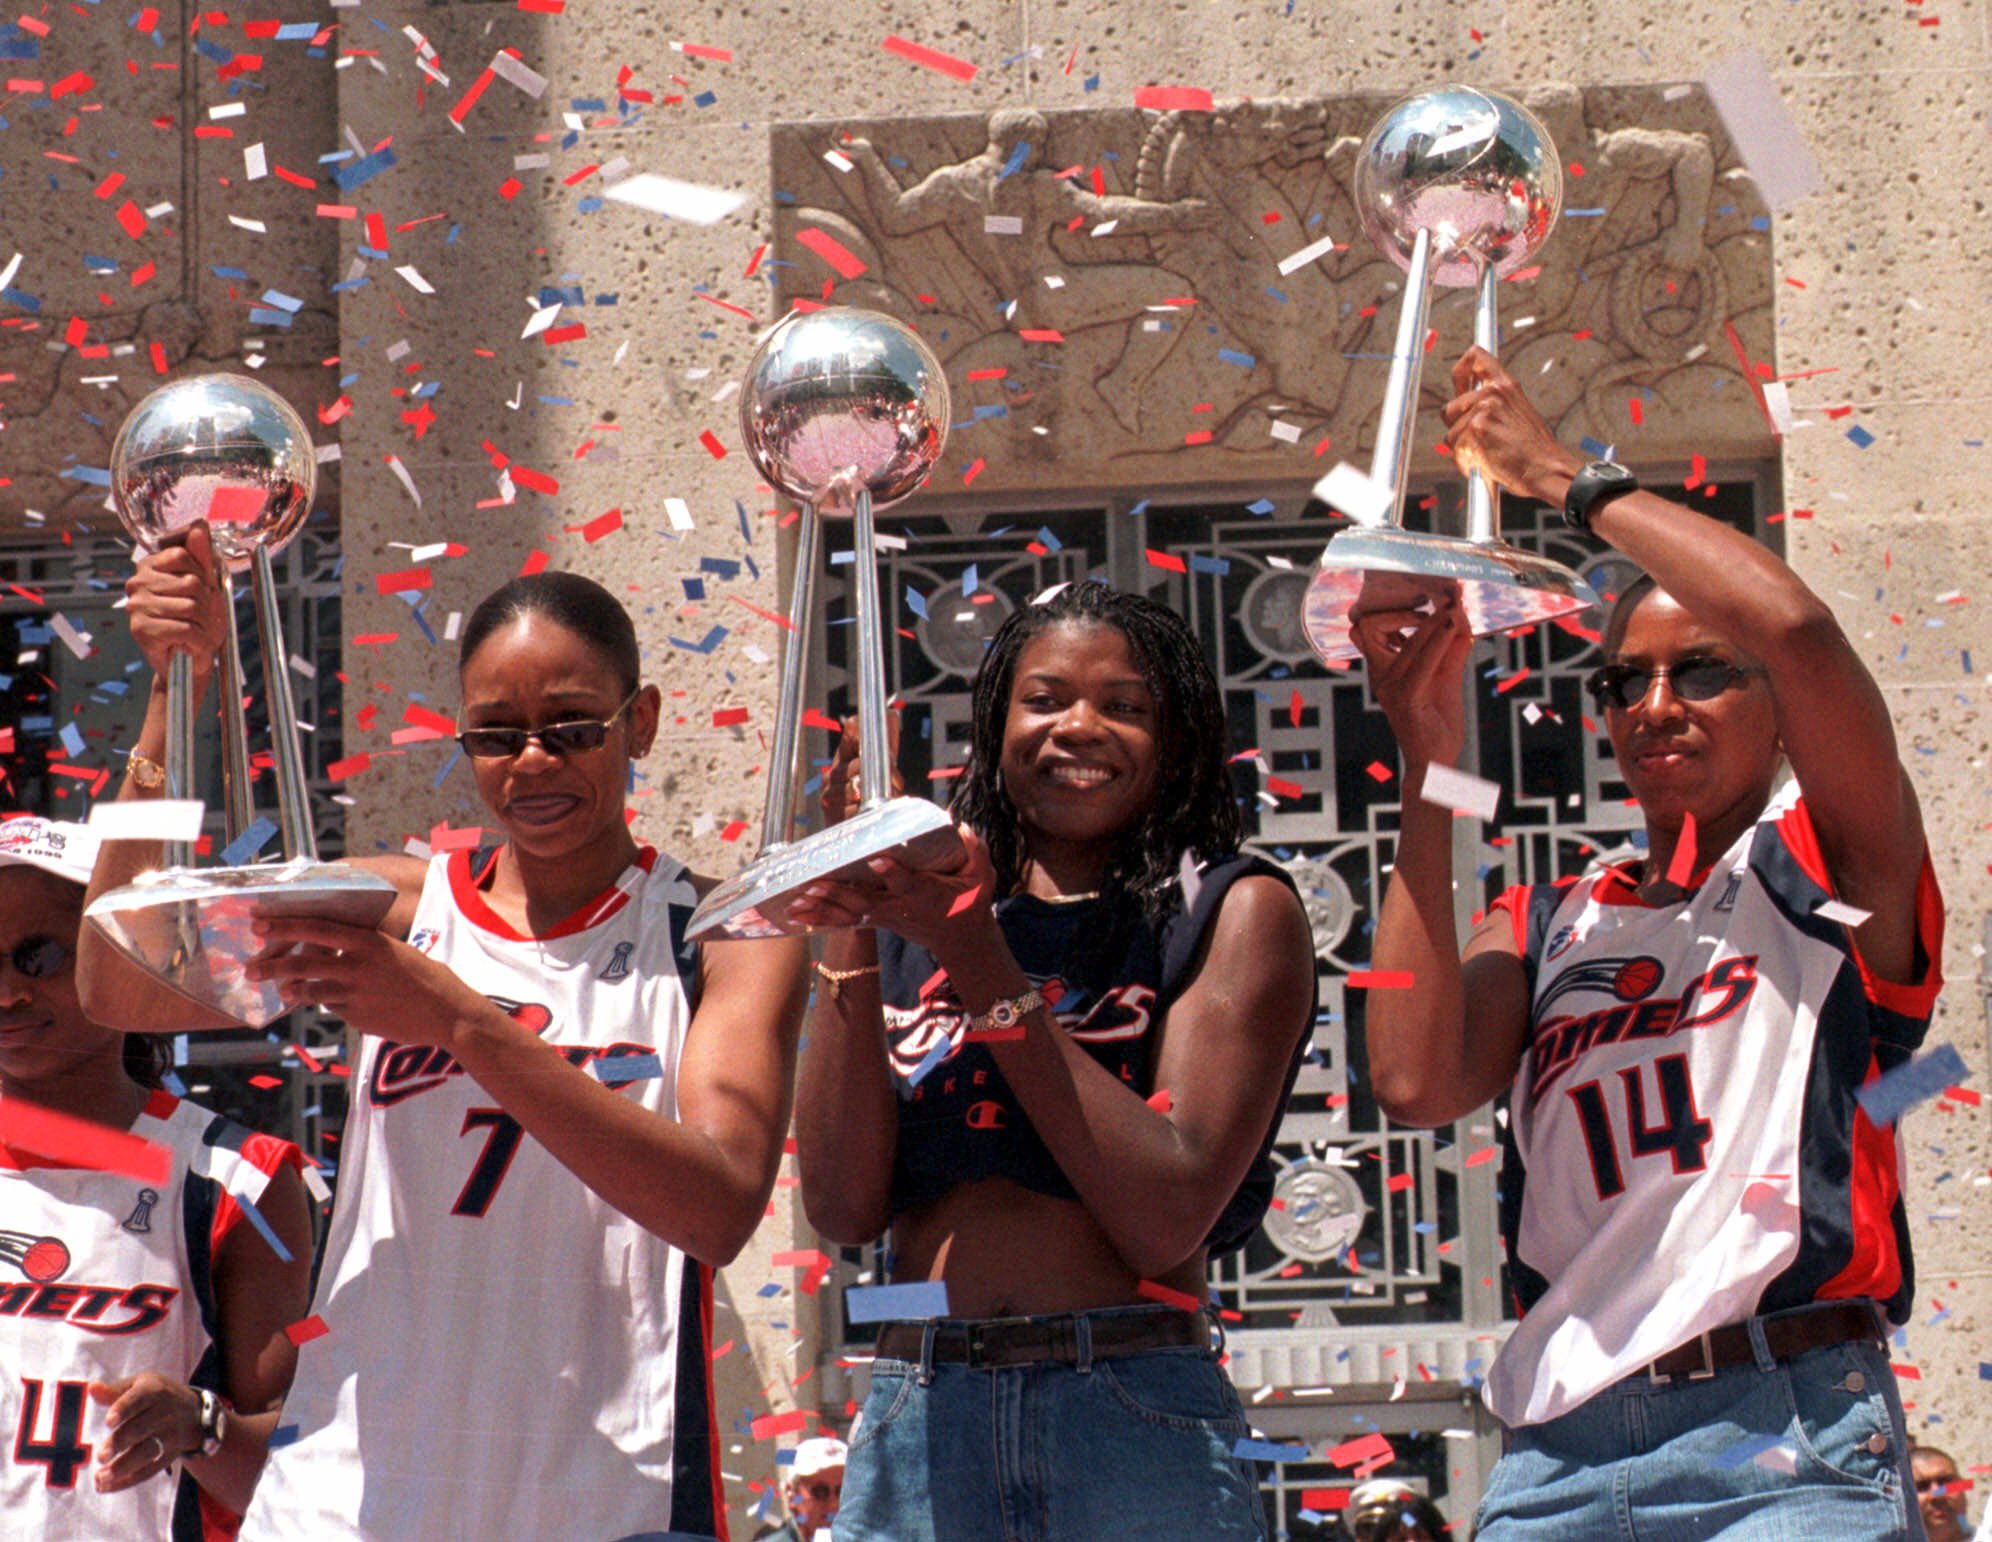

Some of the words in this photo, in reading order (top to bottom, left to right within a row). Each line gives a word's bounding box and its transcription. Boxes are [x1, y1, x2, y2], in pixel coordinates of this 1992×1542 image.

[450, 1107, 526, 1218] 7
[1566, 1052, 1713, 1202] 14
[14, 1376, 92, 1489] 4
